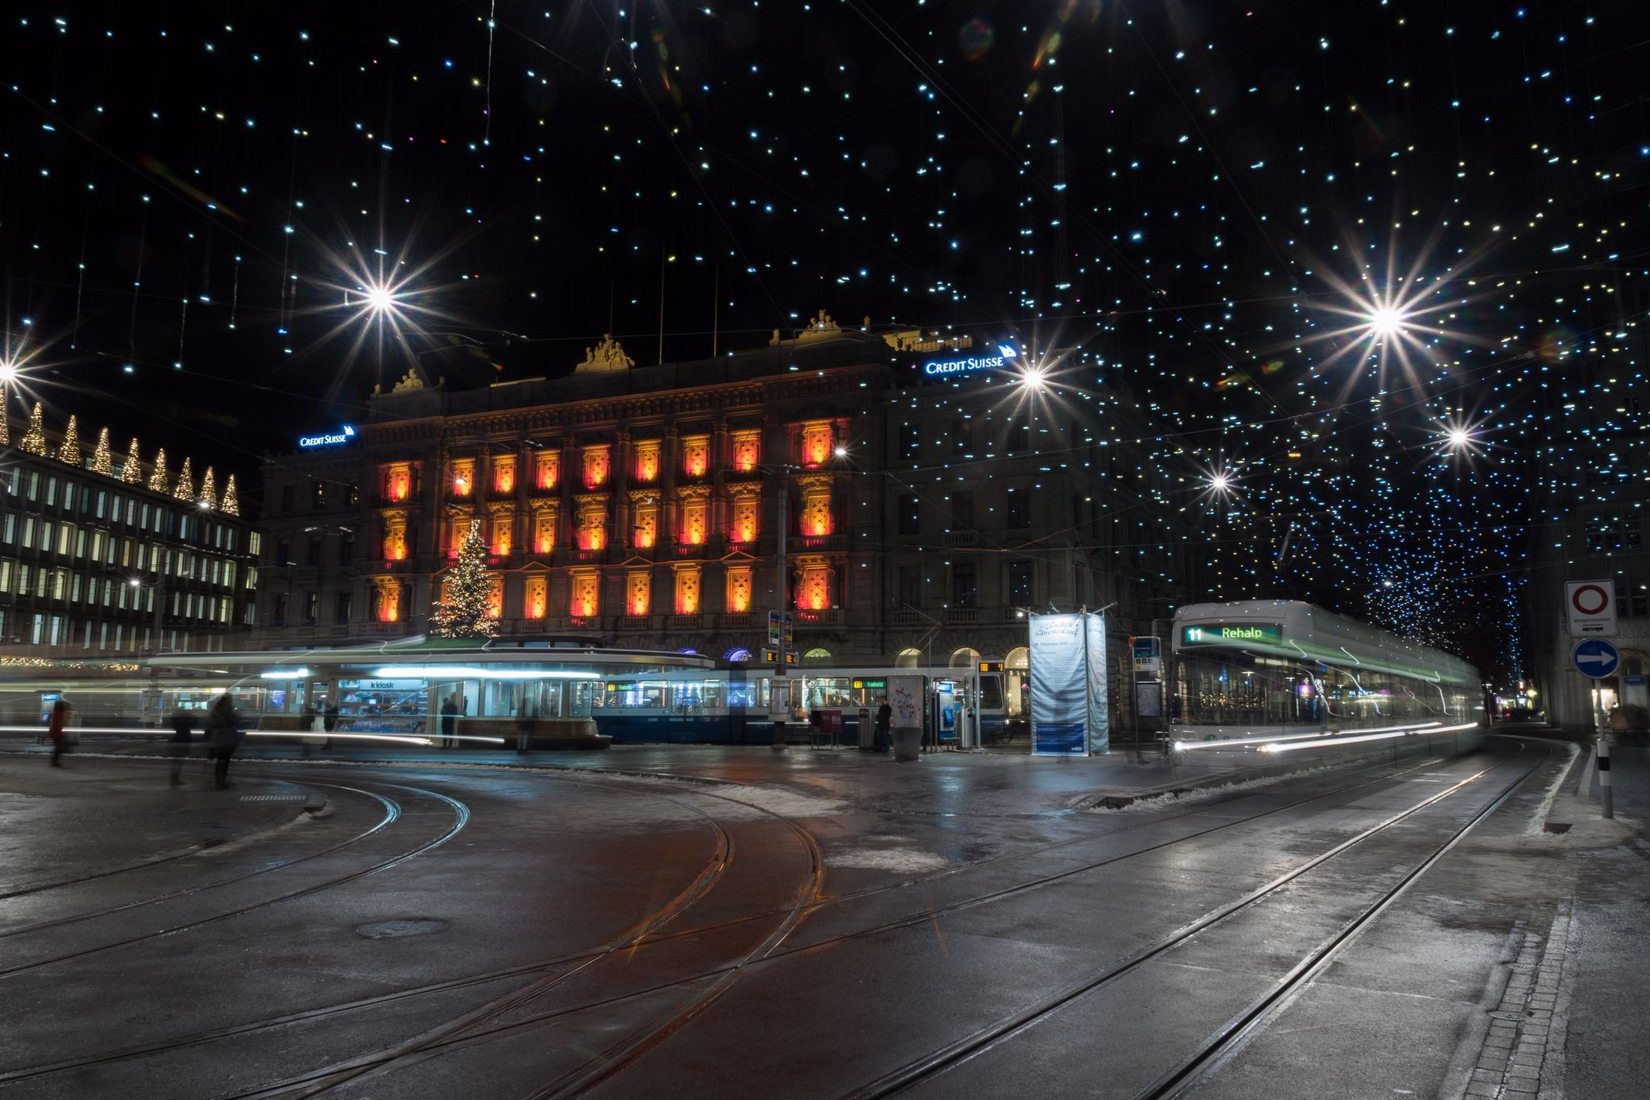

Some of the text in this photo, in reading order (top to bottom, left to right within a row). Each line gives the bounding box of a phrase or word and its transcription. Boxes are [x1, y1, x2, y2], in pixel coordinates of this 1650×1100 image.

[926, 356, 1004, 374] CREDIT SUISSE
[1187, 627, 1263, 641] 11 Rehalp
[376, 681, 394, 689] kiosk
